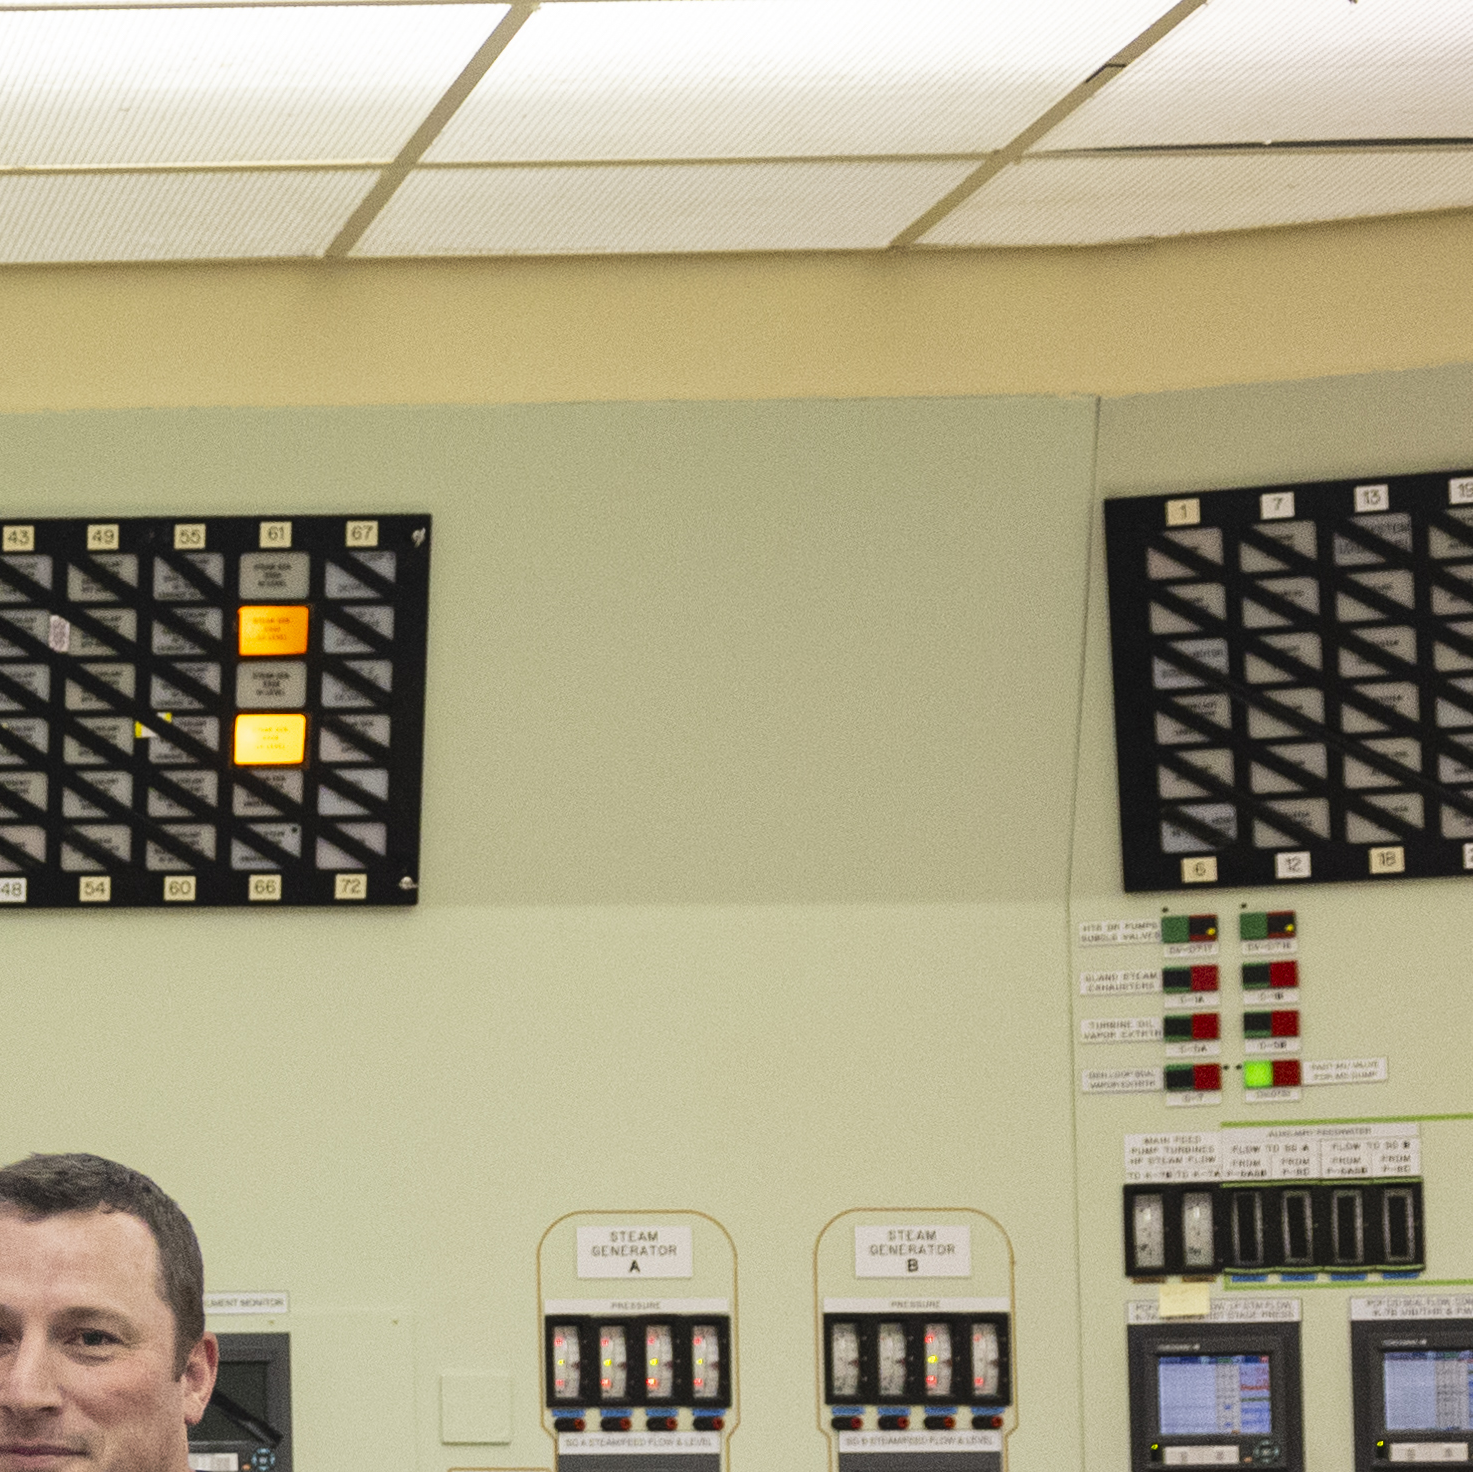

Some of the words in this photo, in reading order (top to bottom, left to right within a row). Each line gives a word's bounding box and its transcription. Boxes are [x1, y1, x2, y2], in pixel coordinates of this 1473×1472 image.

[9, 531, 29, 545] 43
[92, 530, 113, 544] 49
[268, 526, 285, 540] 61
[353, 526, 373, 540] 67
[2, 882, 22, 896] 48
[341, 879, 361, 893] 72
[610, 1231, 658, 1242] STEAM
[888, 1231, 936, 1241] STEAM
[591, 1245, 677, 1256] GENERATOR
[869, 1244, 955, 1255] GENERATOR
[629, 1261, 640, 1272] A
[908, 1260, 918, 1272] B
